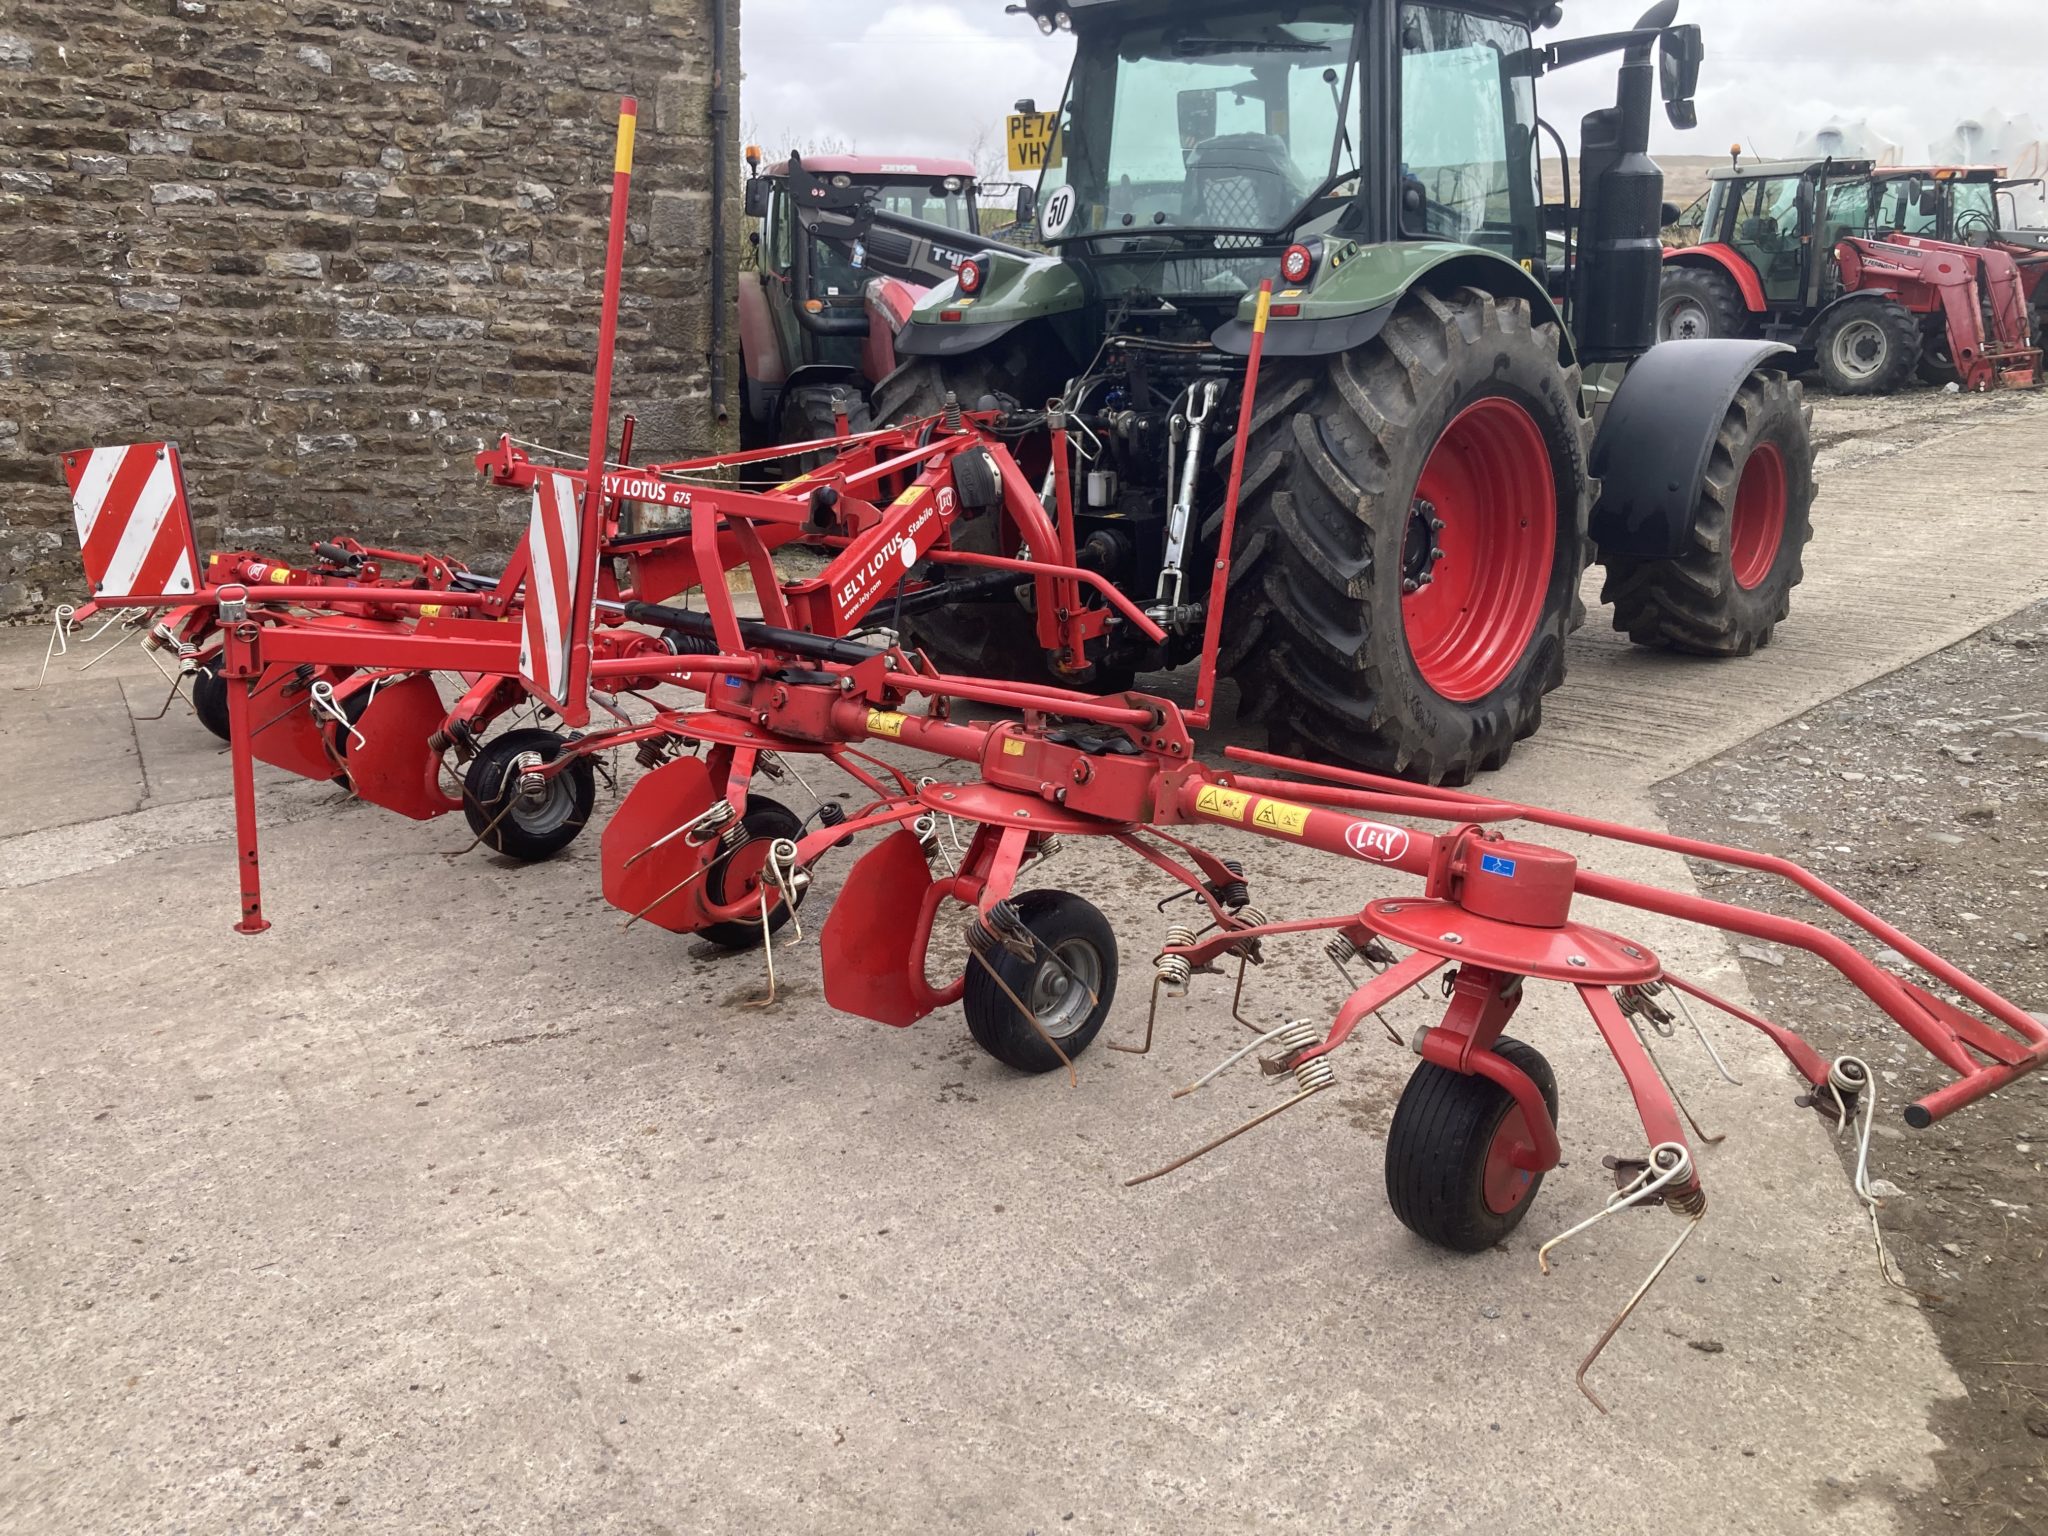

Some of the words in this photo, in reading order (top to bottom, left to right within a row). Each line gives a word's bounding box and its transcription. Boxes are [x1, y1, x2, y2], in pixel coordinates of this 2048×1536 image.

[1047, 194, 1068, 228] 50
[623, 479, 666, 501] LOTUS
[673, 491, 692, 504] 675
[938, 488, 954, 513] LELY
[837, 568, 866, 608] LELY
[867, 532, 904, 578] LOTUS
[908, 507, 933, 538] Stabilo
[844, 579, 882, 620] www.lely.com
[1353, 823, 1403, 857] LELY
